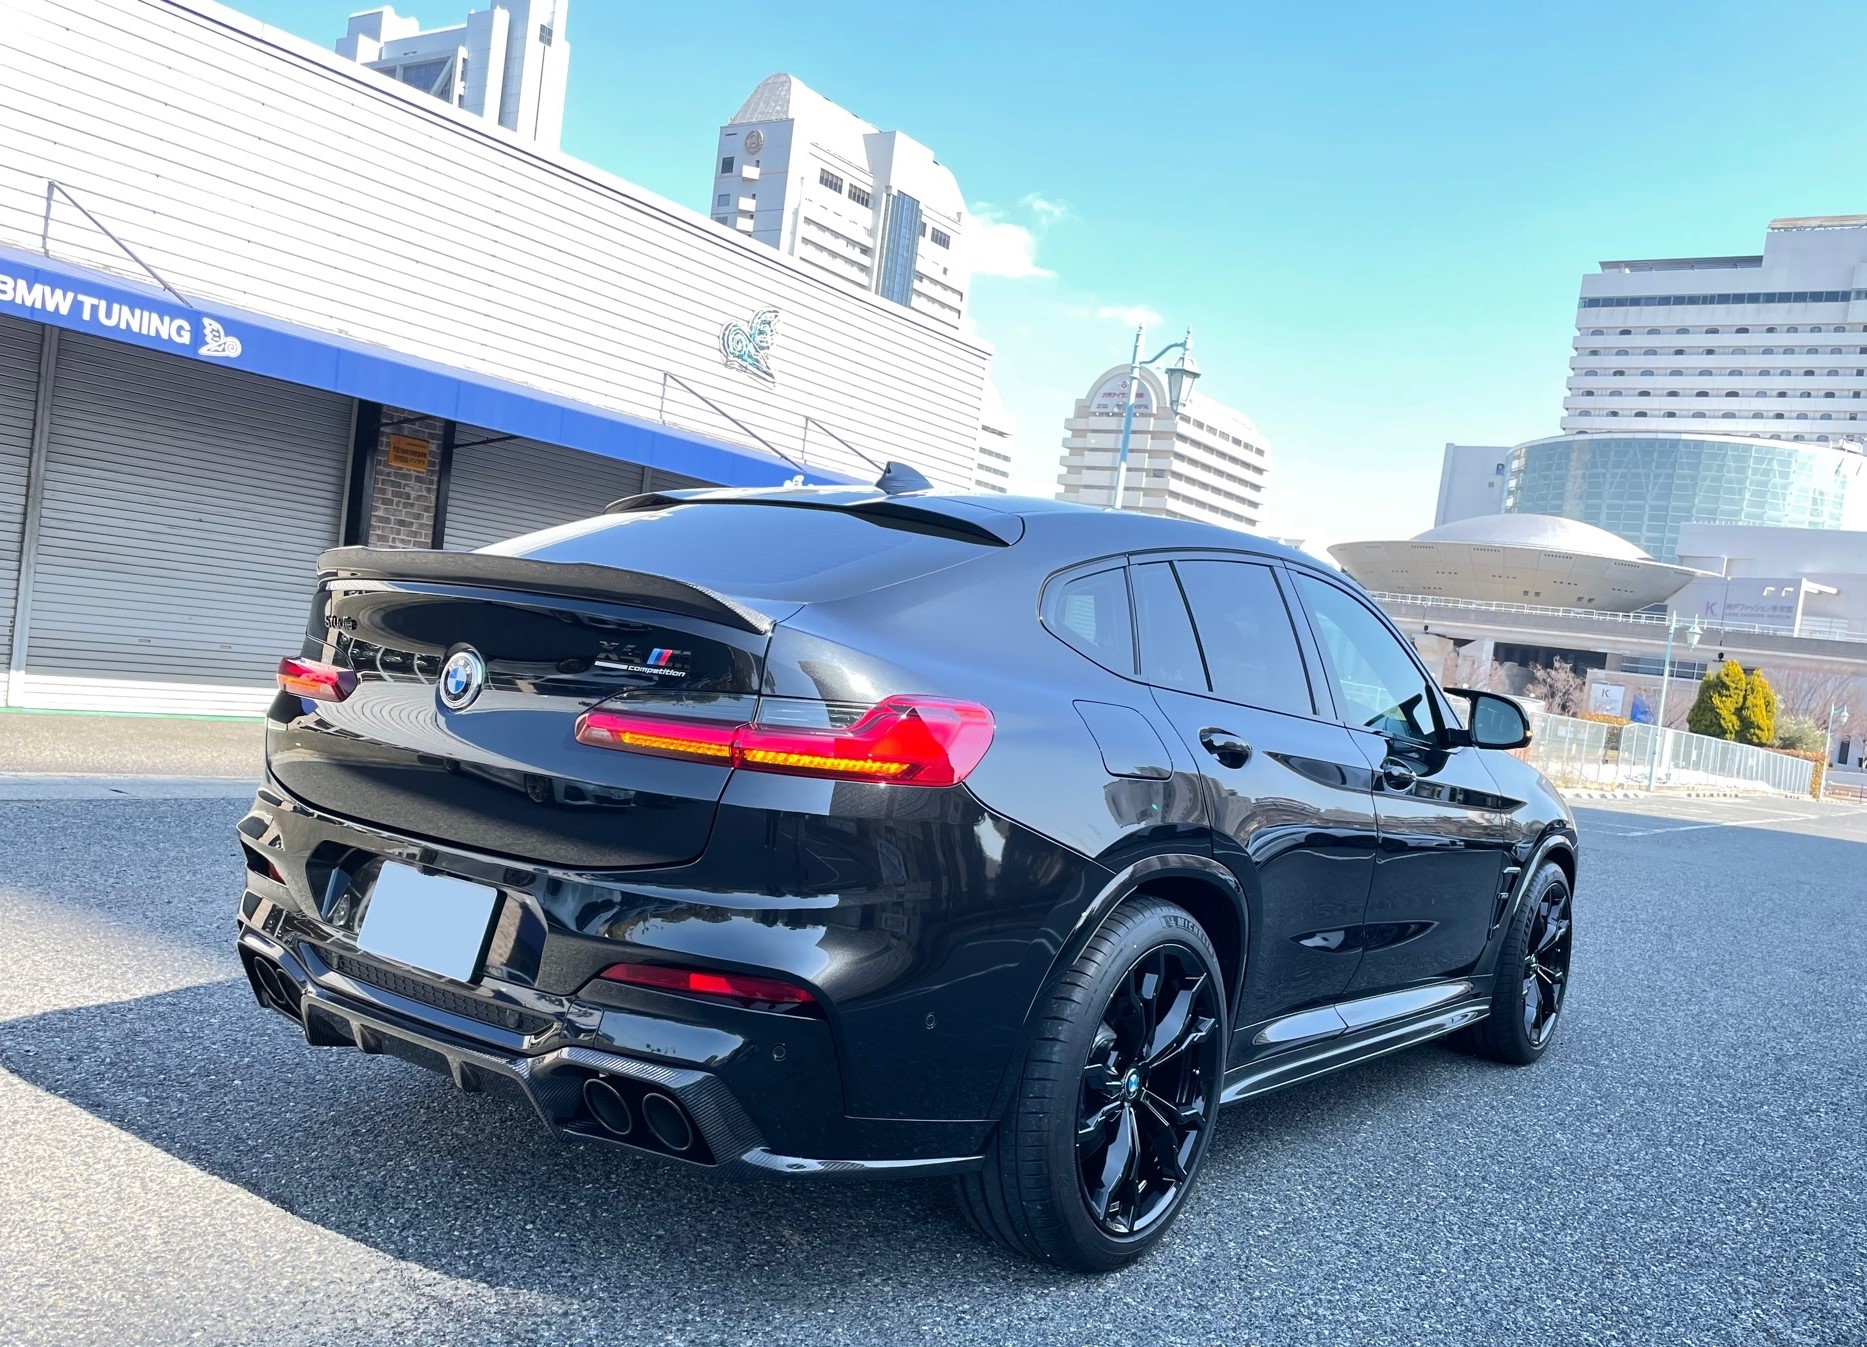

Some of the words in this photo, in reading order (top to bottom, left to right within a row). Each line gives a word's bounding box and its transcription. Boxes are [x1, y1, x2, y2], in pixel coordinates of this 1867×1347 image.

[0, 274, 75, 316] BMW
[77, 293, 191, 345] TUNING
[1704, 600, 1718, 617] K
[627, 664, 686, 678] competition
[1601, 688, 1611, 698] K
